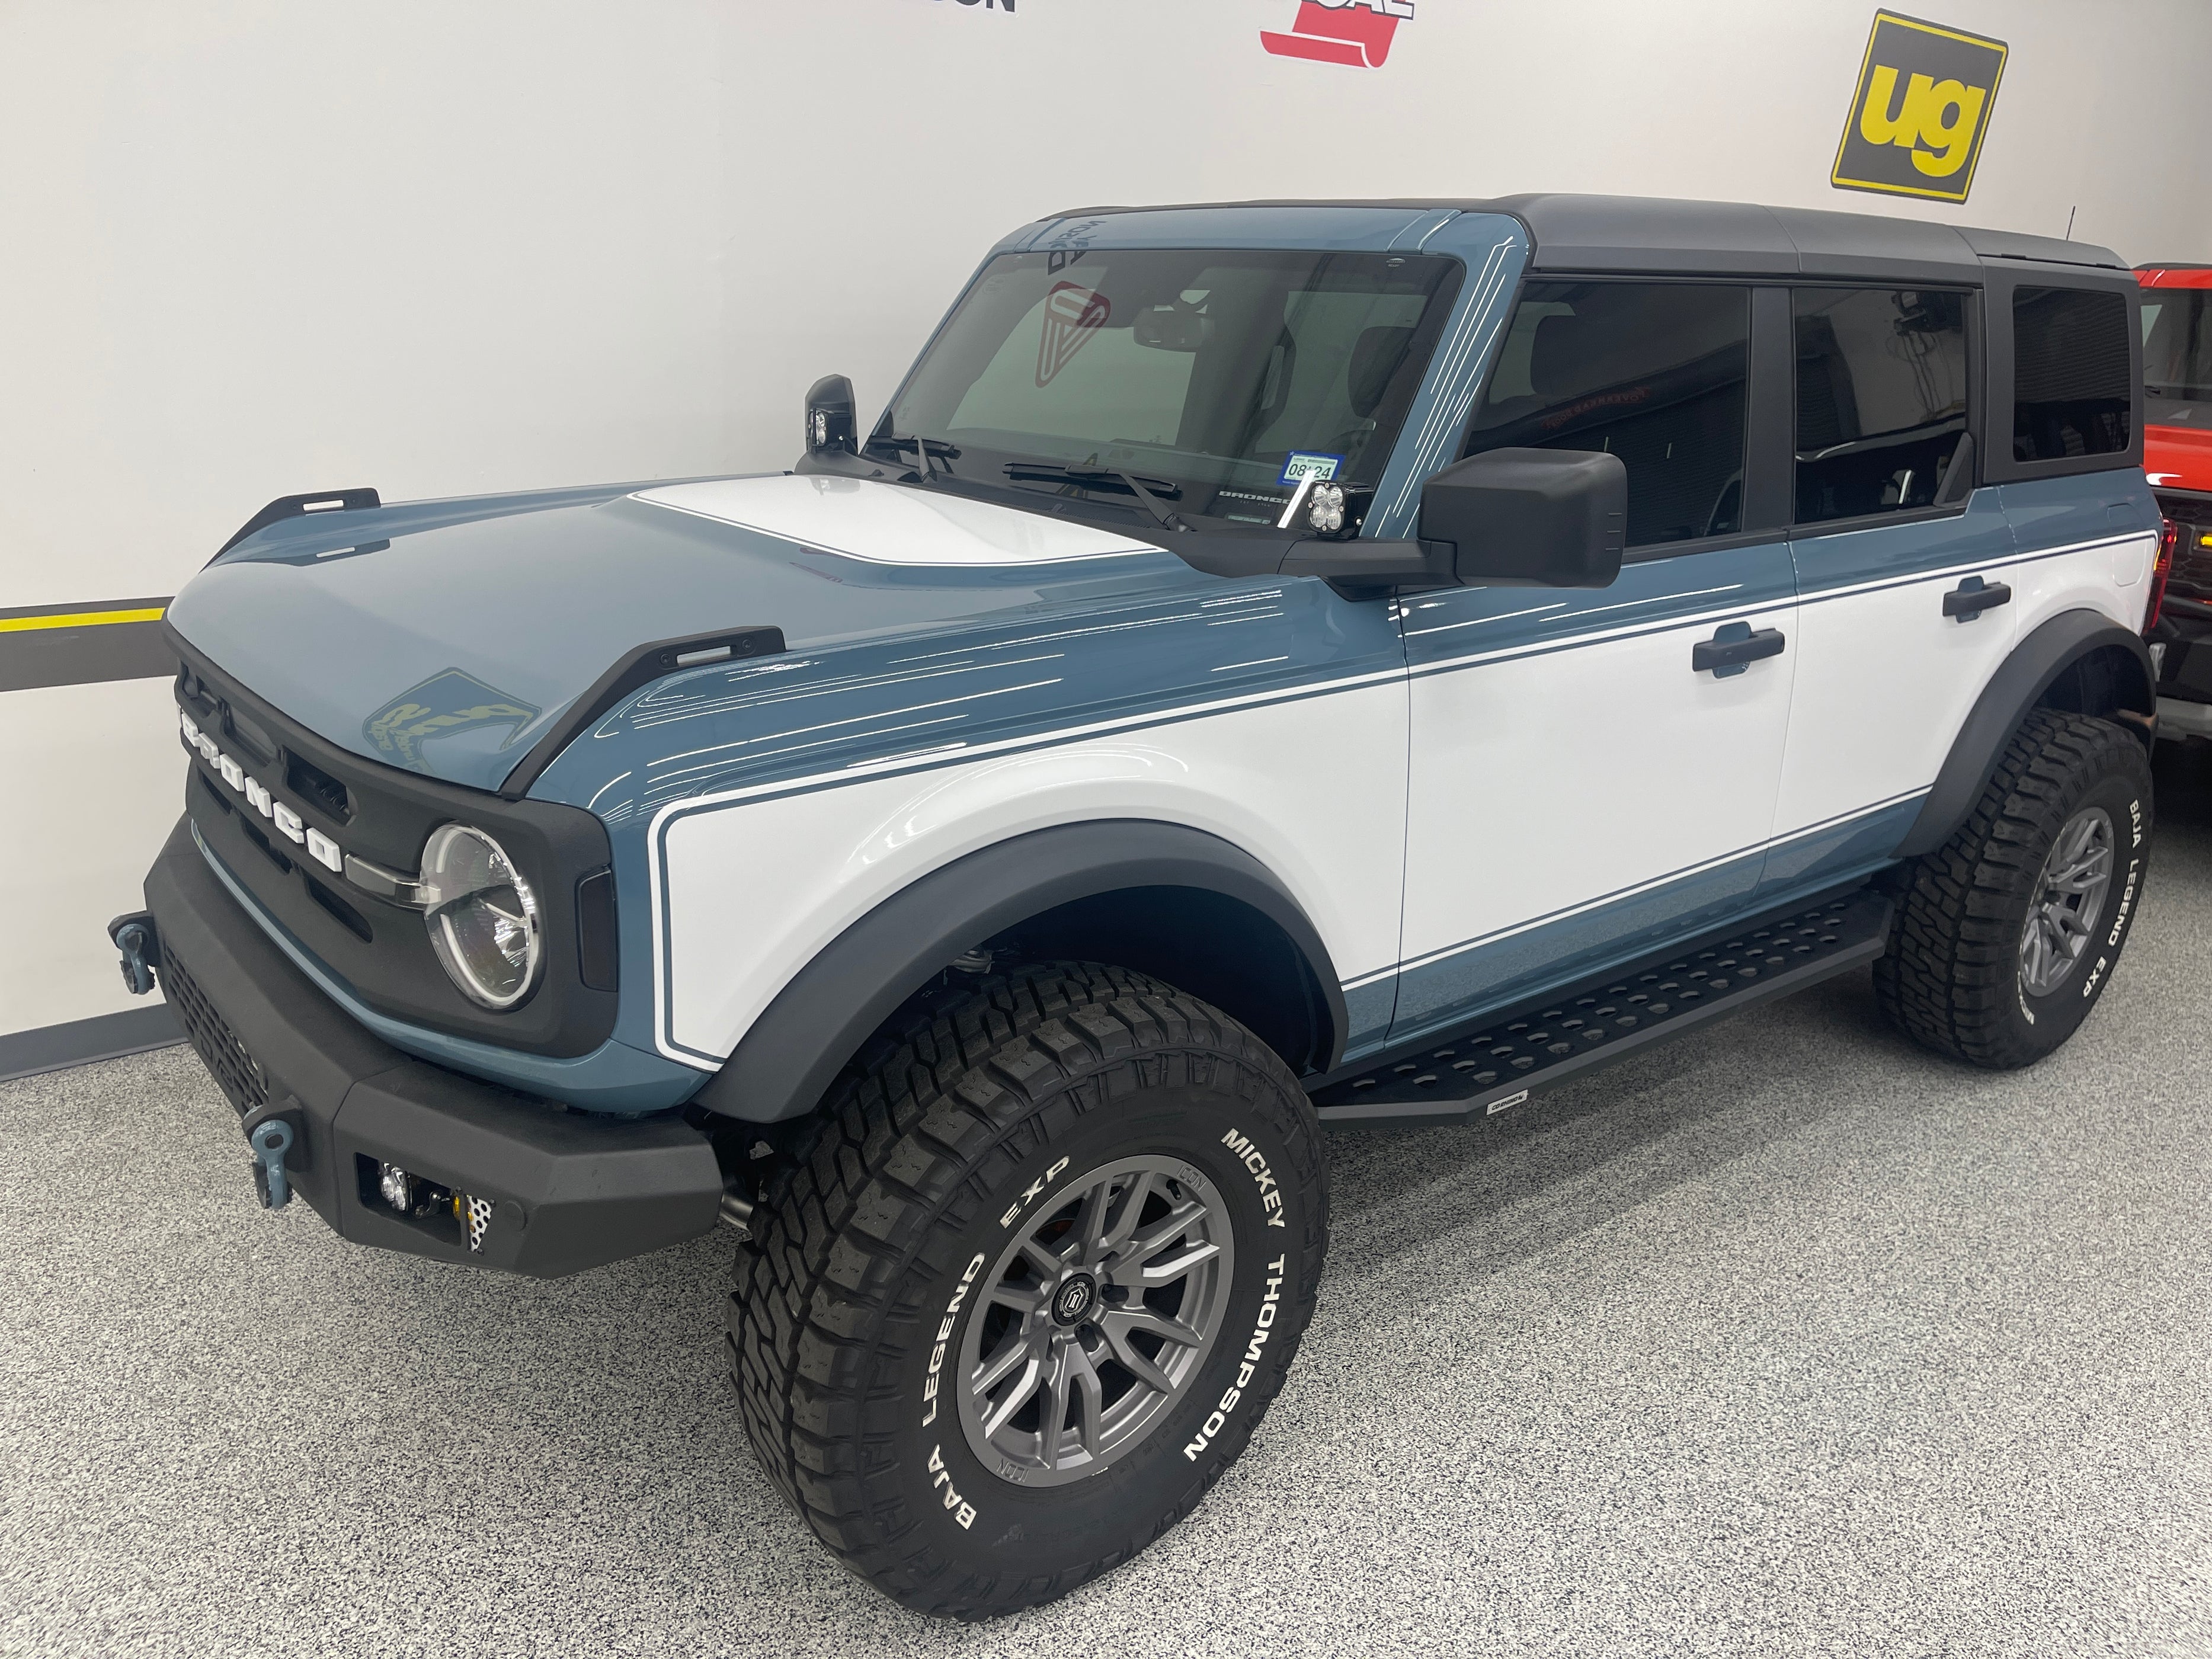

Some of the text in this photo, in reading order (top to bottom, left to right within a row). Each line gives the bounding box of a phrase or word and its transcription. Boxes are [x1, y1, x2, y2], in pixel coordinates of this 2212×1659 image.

[1860, 64, 1986, 177] ug
[1288, 463, 1331, 479] 08 24
[181, 709, 342, 872] BRONCO
[2083, 799, 2141, 998] BAJA LEGEND EXP
[1176, 1165, 1207, 1192] ICON
[921, 1155, 1070, 1530] BAJA LEGEND EXP
[1183, 1128, 1285, 1462] MICKEY THOMPSON
[996, 1458, 1029, 1483] ICON
